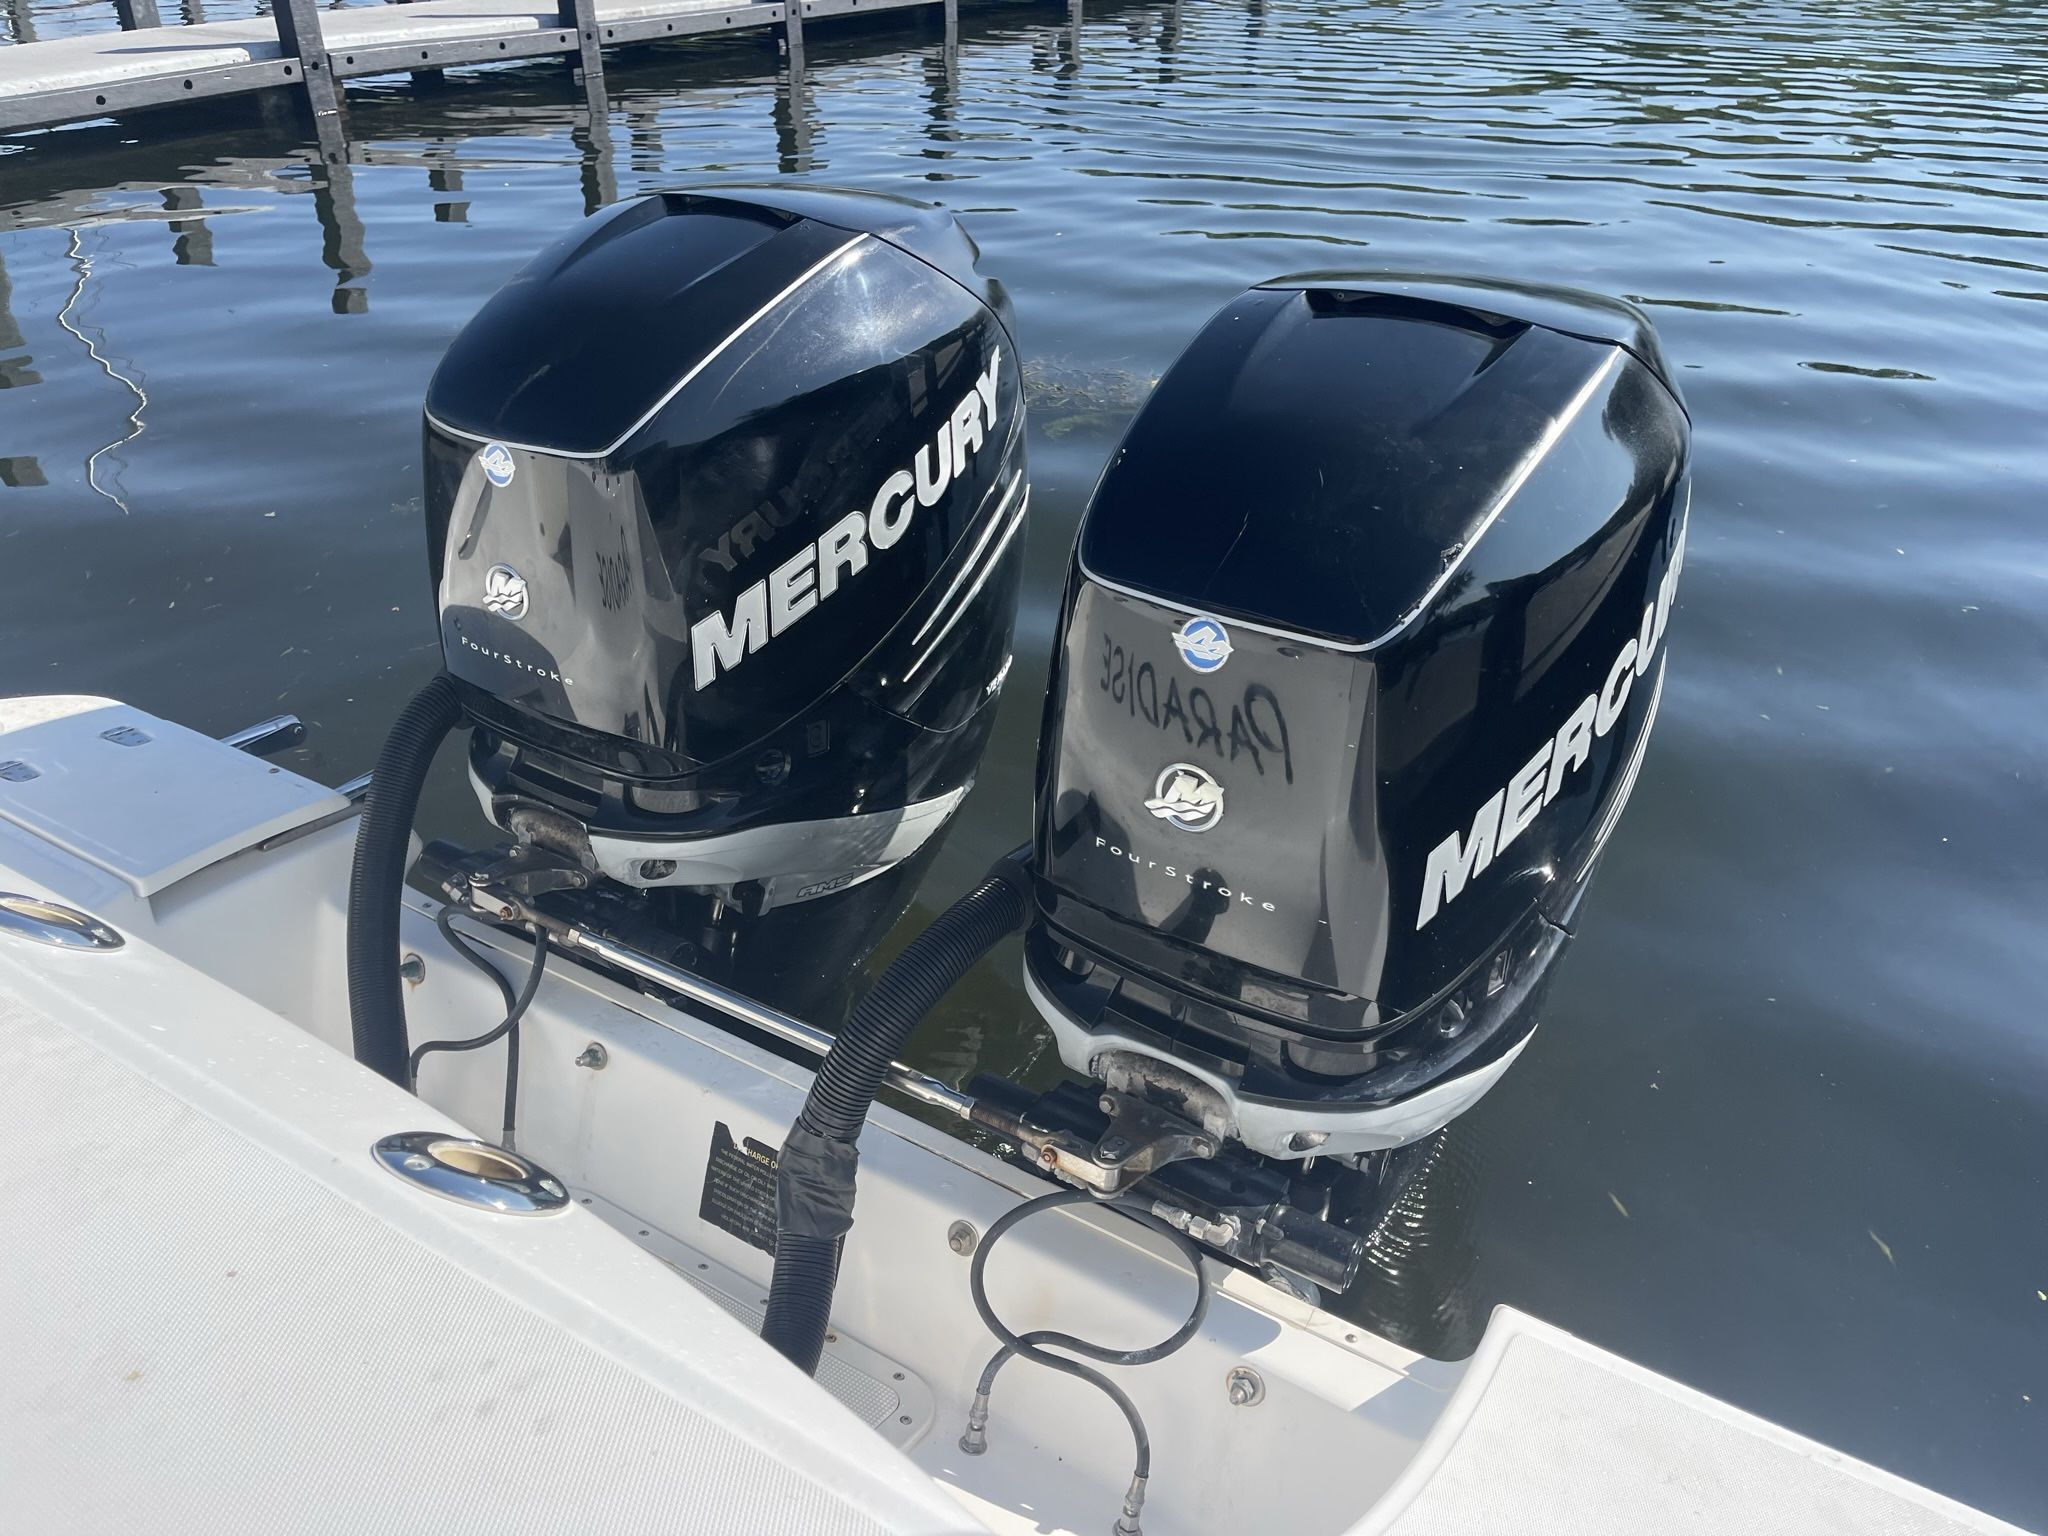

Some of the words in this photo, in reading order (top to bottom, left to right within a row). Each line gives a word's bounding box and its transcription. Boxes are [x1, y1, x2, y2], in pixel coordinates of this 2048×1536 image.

[691, 345, 1000, 692] MERCURY
[797, 872, 855, 898] AMS
[1095, 836, 1276, 912] FourStroke
